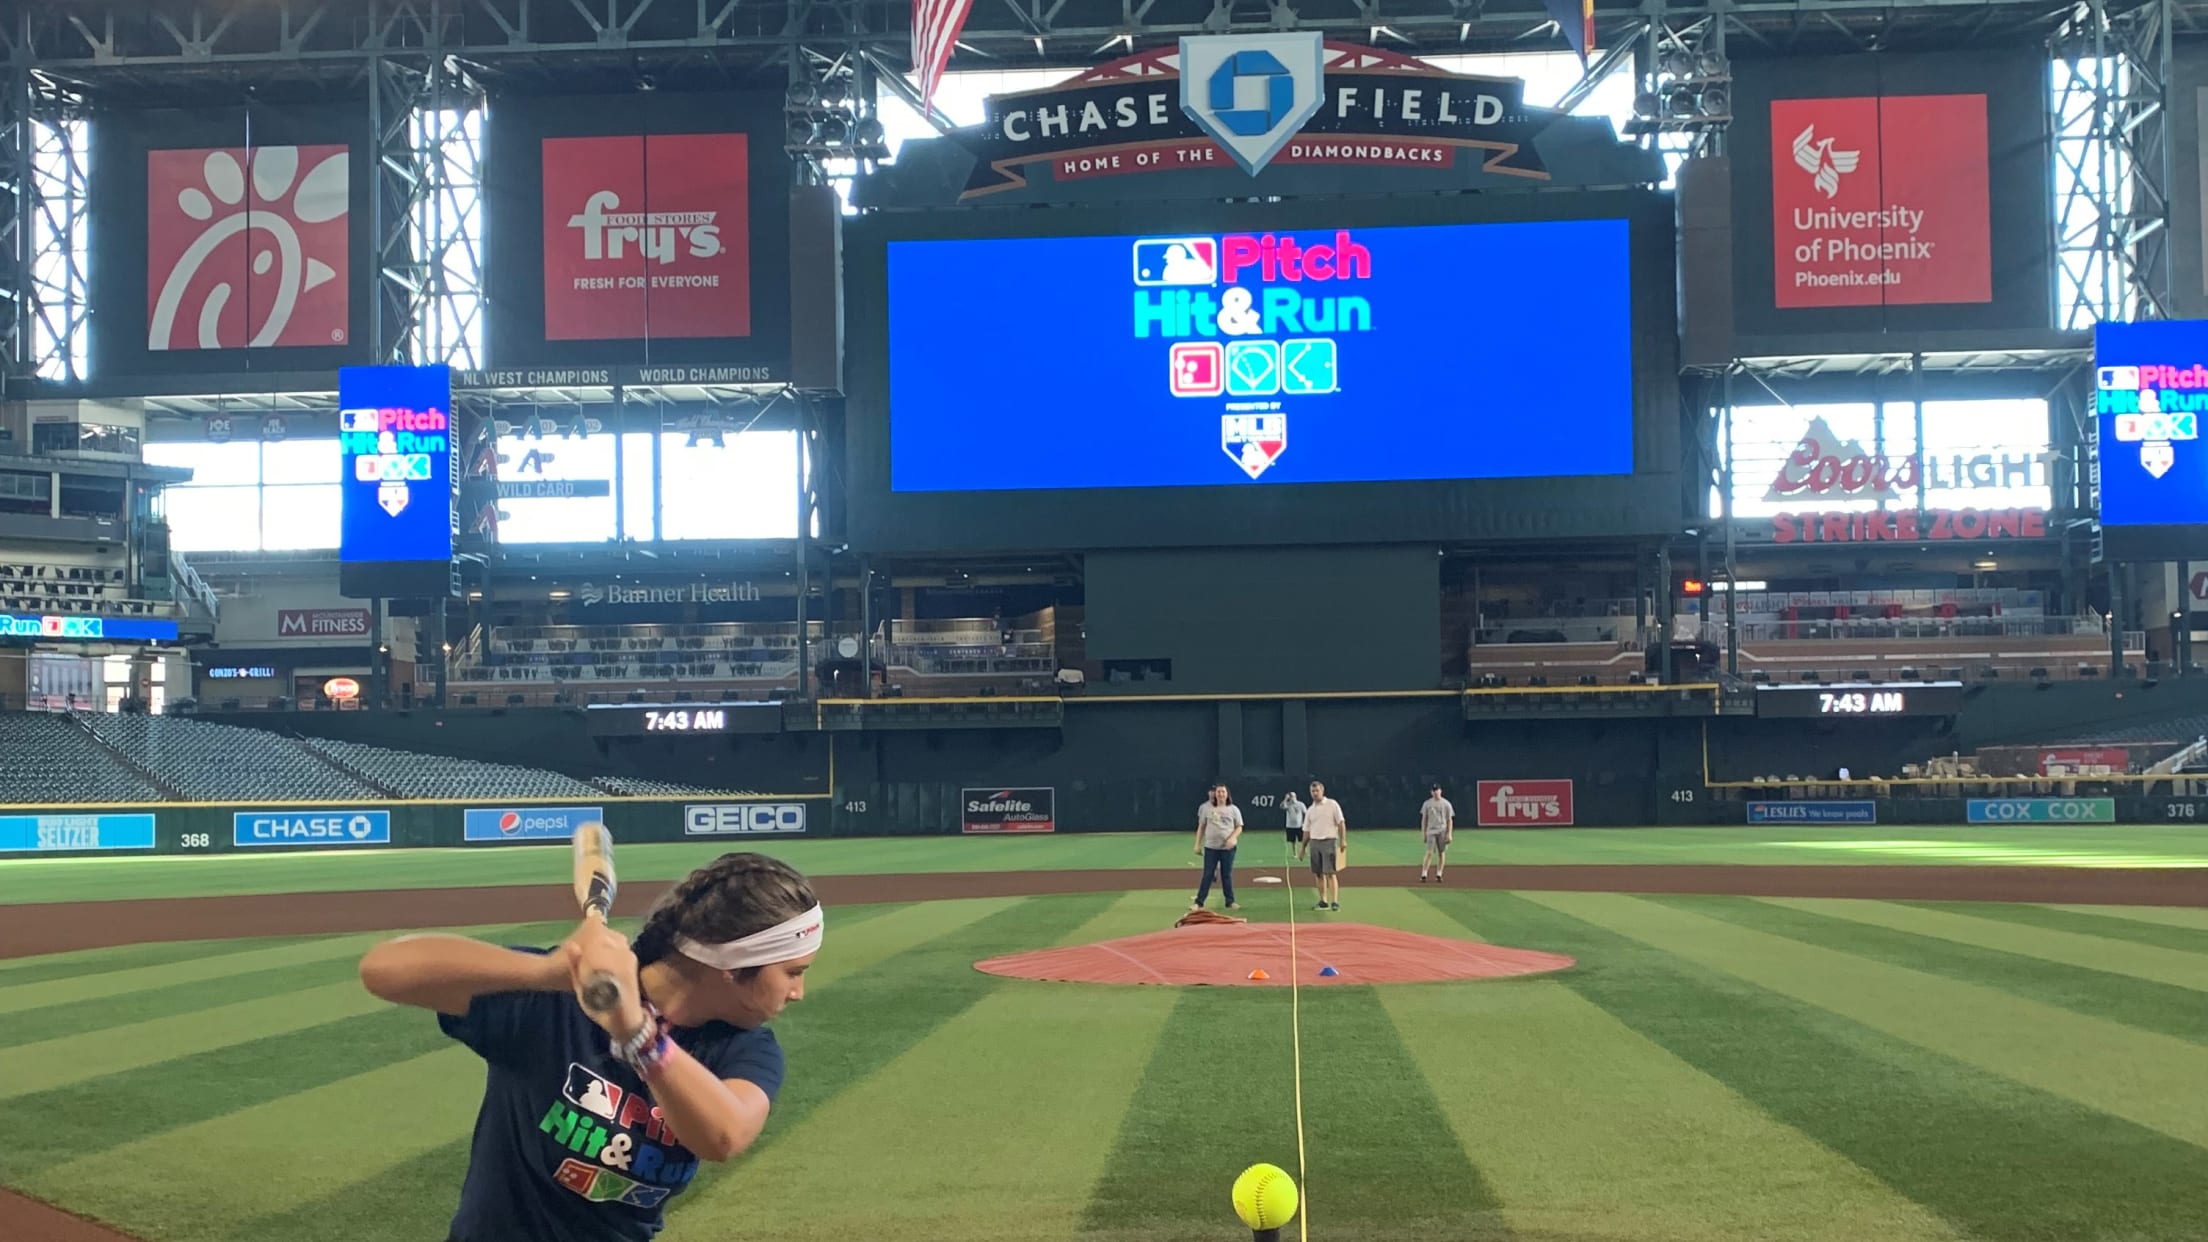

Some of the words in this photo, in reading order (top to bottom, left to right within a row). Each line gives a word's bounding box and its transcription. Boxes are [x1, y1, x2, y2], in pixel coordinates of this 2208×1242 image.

[1003, 94, 1168, 142] CHASE
[1337, 87, 1504, 126] FIELD
[1064, 156, 1121, 174] HOME
[1136, 152, 1161, 166] OF
[1177, 148, 1214, 161] THE
[1291, 145, 1443, 162] DIAMONDBACKS
[567, 190, 721, 265] fry's
[655, 213, 711, 224] STORES
[1794, 205, 1924, 234] University
[1222, 230, 1371, 283] Pitch
[1795, 238, 1822, 262] of
[1828, 237, 1931, 261] Phoenix
[573, 277, 614, 290] FRESH
[618, 276, 646, 288] FOR
[651, 275, 719, 288] EVERYONE
[1795, 269, 1901, 287] Phoenix.edu
[463, 373, 480, 386] NL
[485, 371, 523, 385] WEST
[528, 370, 609, 384] CHAMPIONS
[639, 368, 685, 382] WORLD
[690, 367, 769, 382] CHAMPIONS
[2140, 364, 2208, 389] Pitch
[209, 420, 231, 431] JOE
[378, 407, 446, 432] Pitch
[1772, 437, 1921, 493] Coors
[1929, 450, 2060, 489] LIGHT
[497, 483, 532, 497] WILD
[537, 482, 574, 496] CARD
[1773, 510, 1919, 543] STRIKE
[1927, 507, 2046, 540] ZONE
[607, 584, 686, 605] Banner
[690, 581, 760, 604] Health
[281, 614, 307, 633] M
[312, 619, 365, 633] FITNESS
[1819, 693, 1866, 713] 7:43
[1870, 693, 1904, 712] AM
[645, 711, 689, 730] 7:43
[693, 711, 724, 730] AM
[1251, 796, 1275, 807] 407
[1490, 786, 1560, 820] fry's
[1671, 790, 1694, 802] 413
[845, 801, 867, 813] 413
[967, 800, 1032, 813] Safelite
[1984, 803, 2031, 819] COX
[2047, 802, 2097, 819] COX
[2167, 803, 2195, 818] 376
[524, 815, 568, 833] pepsi
[687, 806, 804, 833] GEICO
[1004, 812, 1049, 821] AutoGlass
[37, 826, 99, 849] SELTZER
[253, 818, 344, 839] CHASE
[181, 833, 210, 848] 368
[619, 1093, 678, 1147] Pit
